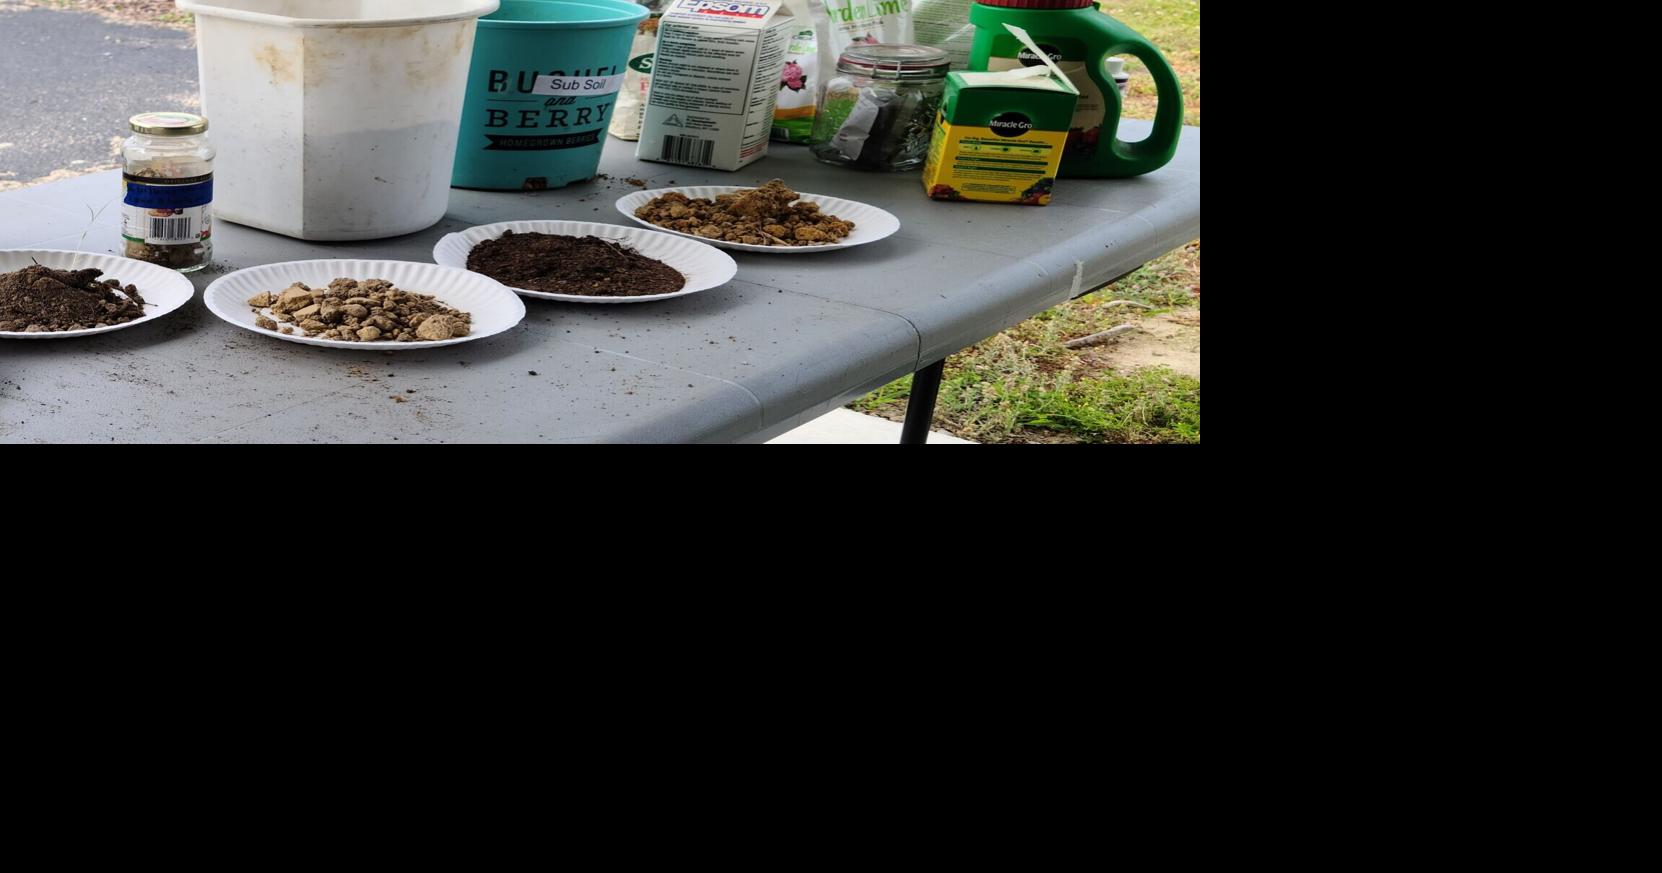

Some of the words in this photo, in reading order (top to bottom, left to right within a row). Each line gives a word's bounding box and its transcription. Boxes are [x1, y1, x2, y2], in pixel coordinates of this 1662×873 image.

[678, 0, 769, 15] Epsom
[825, 0, 866, 22] rden
[550, 79, 580, 91] Sub
[583, 79, 607, 91] Soil
[485, 102, 611, 128] BERRY
[989, 120, 1018, 129] Miracle
